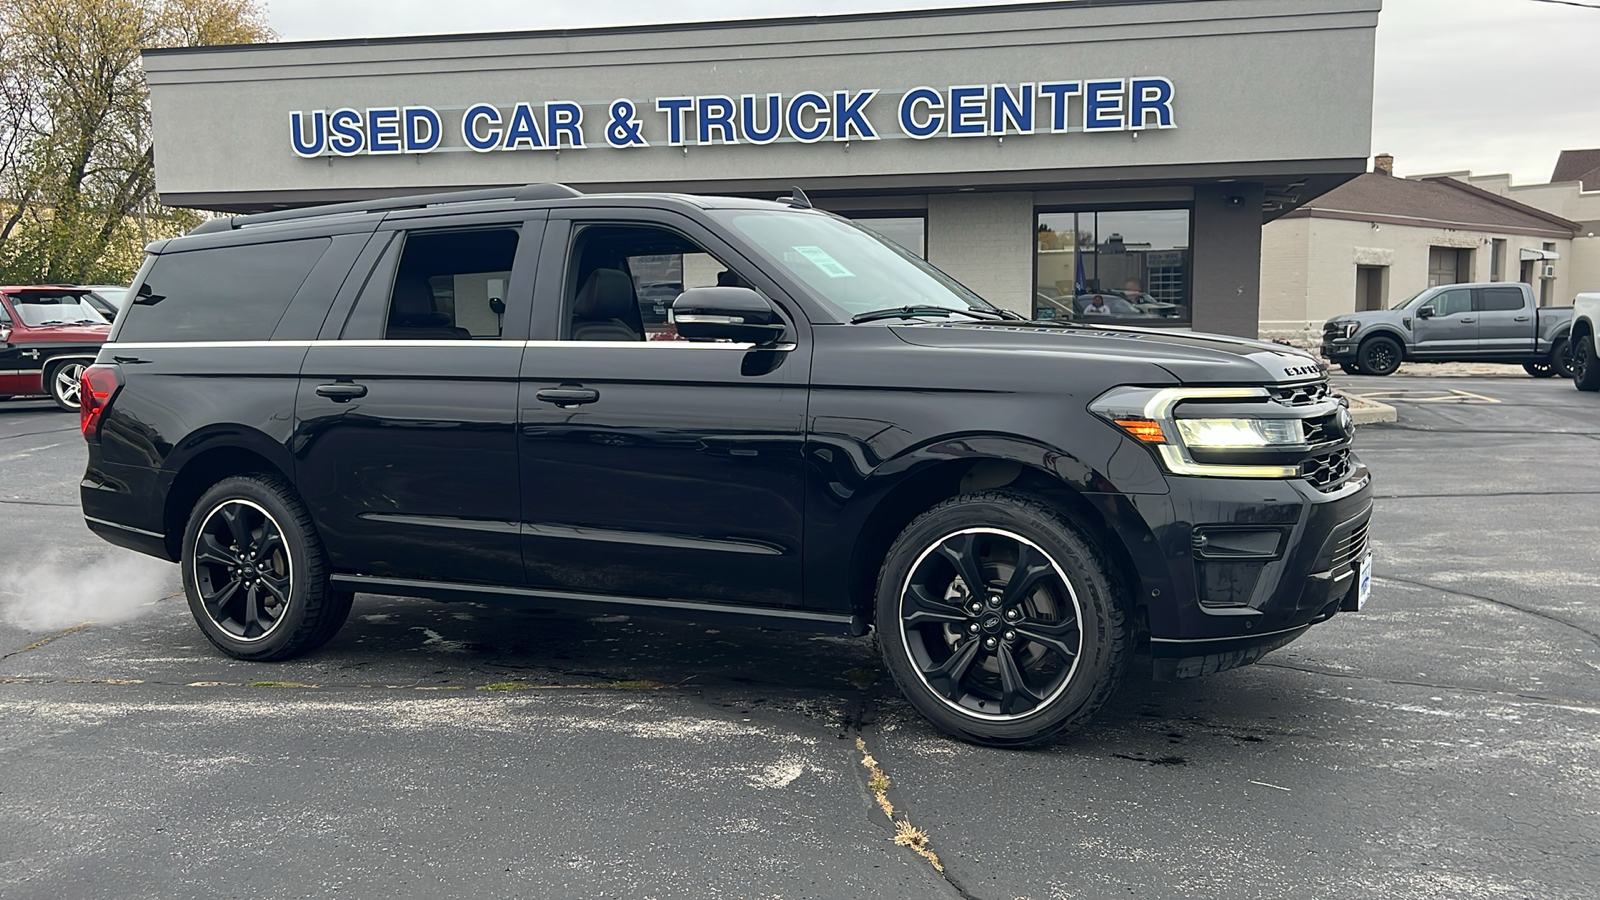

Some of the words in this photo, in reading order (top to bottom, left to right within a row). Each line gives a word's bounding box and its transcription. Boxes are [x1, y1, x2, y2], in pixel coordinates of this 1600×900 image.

[289, 107, 442, 158] USED
[462, 101, 587, 152] CAR
[604, 98, 650, 149] &
[656, 88, 881, 146] TRUCK
[898, 76, 1178, 140] CENTER
